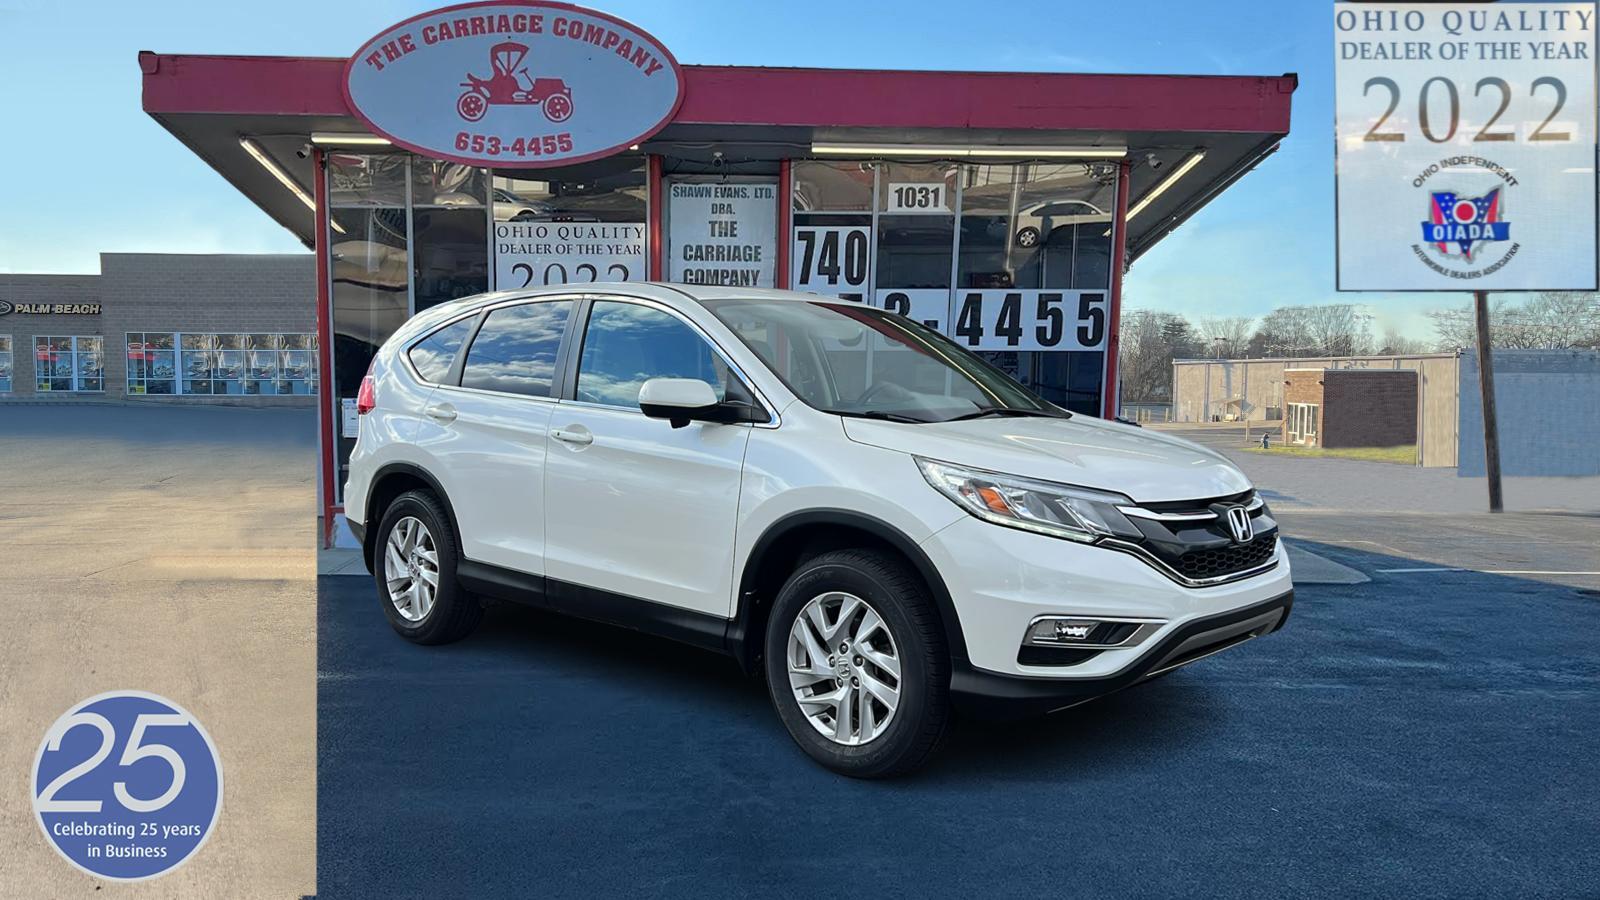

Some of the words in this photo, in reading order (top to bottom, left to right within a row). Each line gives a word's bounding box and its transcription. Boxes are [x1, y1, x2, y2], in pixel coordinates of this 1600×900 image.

[1336, 10, 1425, 31] OHIO
[1442, 10, 1593, 36] QUALITY
[366, 34, 416, 71] THE
[422, 14, 543, 45] CARRIAGE
[552, 17, 664, 77] COMPANY
[1340, 42, 1433, 60] DEALER
[1439, 42, 1469, 60] OF
[1475, 42, 1522, 60] THE
[1528, 42, 1589, 60] YEAR
[1363, 76, 1571, 143] 2022
[455, 132, 573, 156] 653-4455
[1412, 164, 1439, 188] OHIO
[1440, 155, 1519, 187] INDEPENDENT
[672, 186, 712, 199] SHAWN
[754, 186, 775, 199] LTD.
[895, 187, 940, 208] 1031
[711, 203, 736, 215] DBA.
[497, 226, 548, 239] OHIO
[558, 226, 644, 241] QUALITY
[709, 221, 737, 237] THE
[1432, 224, 1495, 240] OIADA
[500, 243, 552, 255] DEALER
[556, 243, 573, 255] OF
[576, 243, 603, 255] THE
[606, 243, 642, 255] YEAR
[683, 245, 762, 262] CARRIAGE
[797, 230, 868, 287] 740
[683, 269, 760, 287] COMPANY
[1449, 269, 1482, 280] DEALERS
[15, 304, 50, 314] PALM
[54, 304, 100, 314] BEACH
